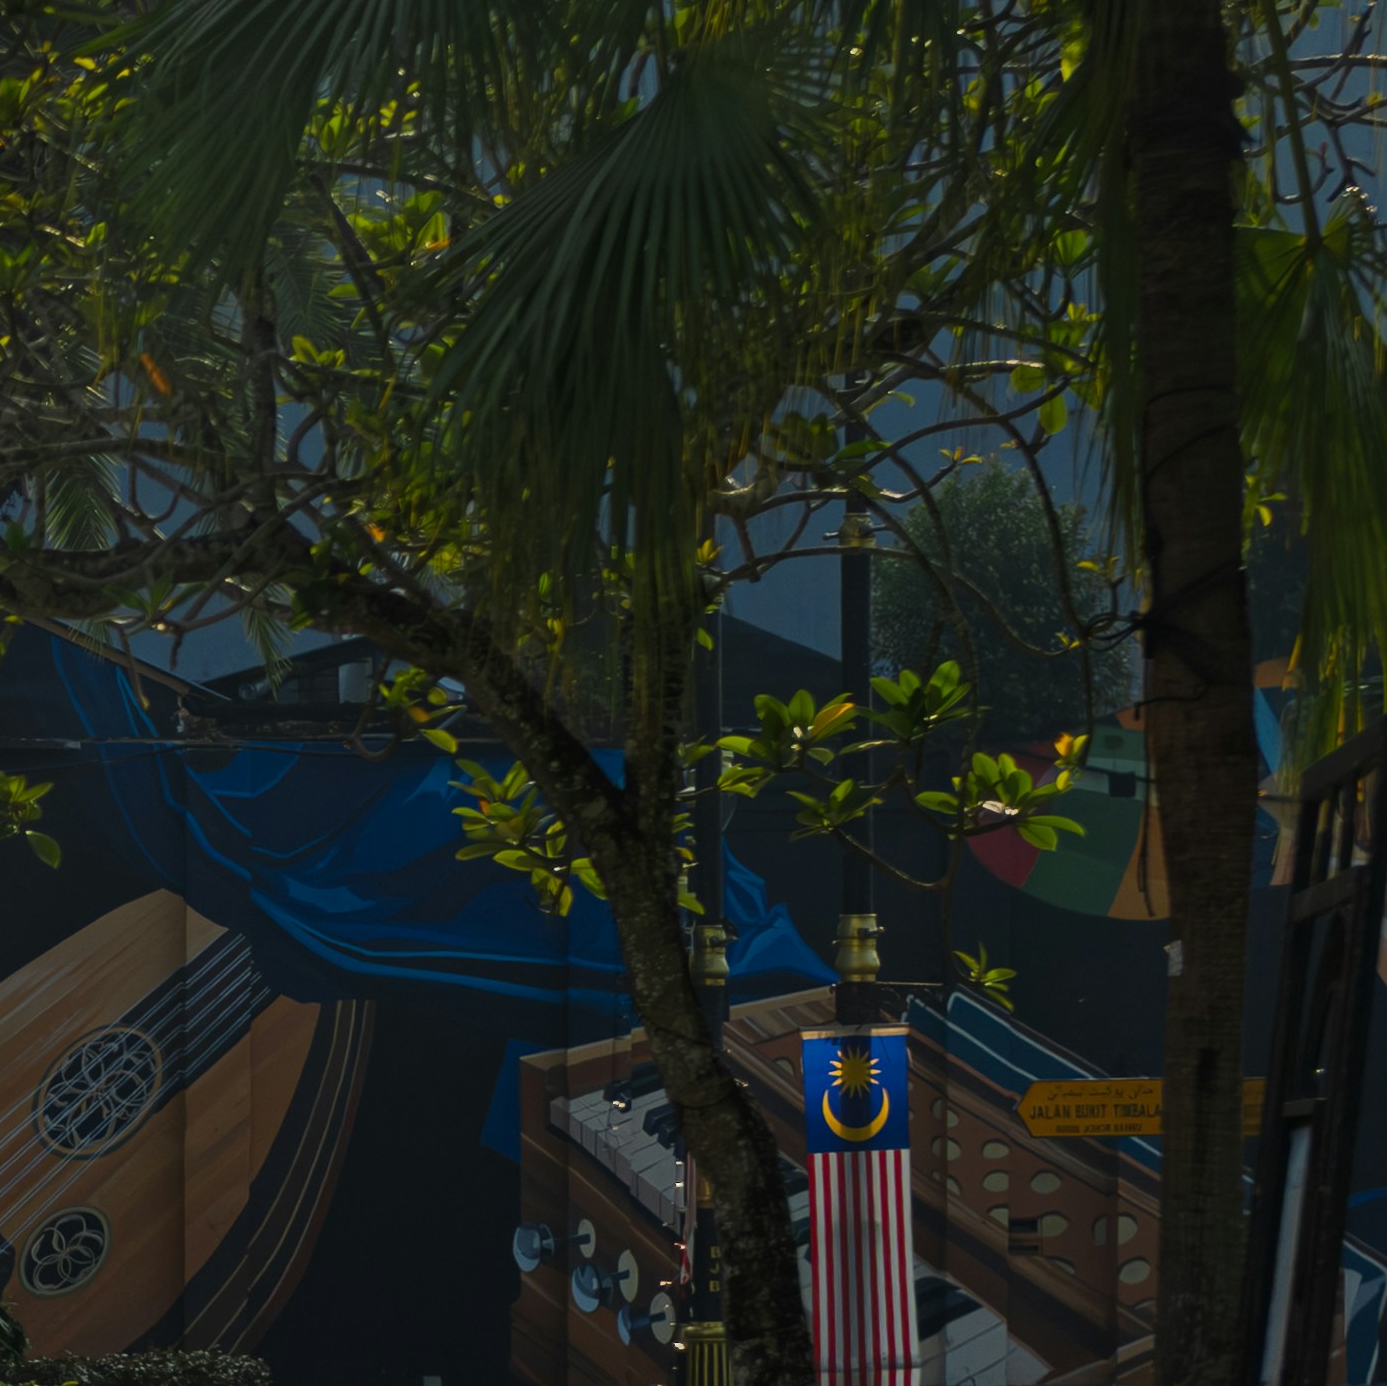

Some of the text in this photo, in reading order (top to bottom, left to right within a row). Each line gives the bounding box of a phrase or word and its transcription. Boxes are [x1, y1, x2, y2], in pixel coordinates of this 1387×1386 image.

[1029, 1102, 1160, 1120] JALAN BUKIT TIMBALA
